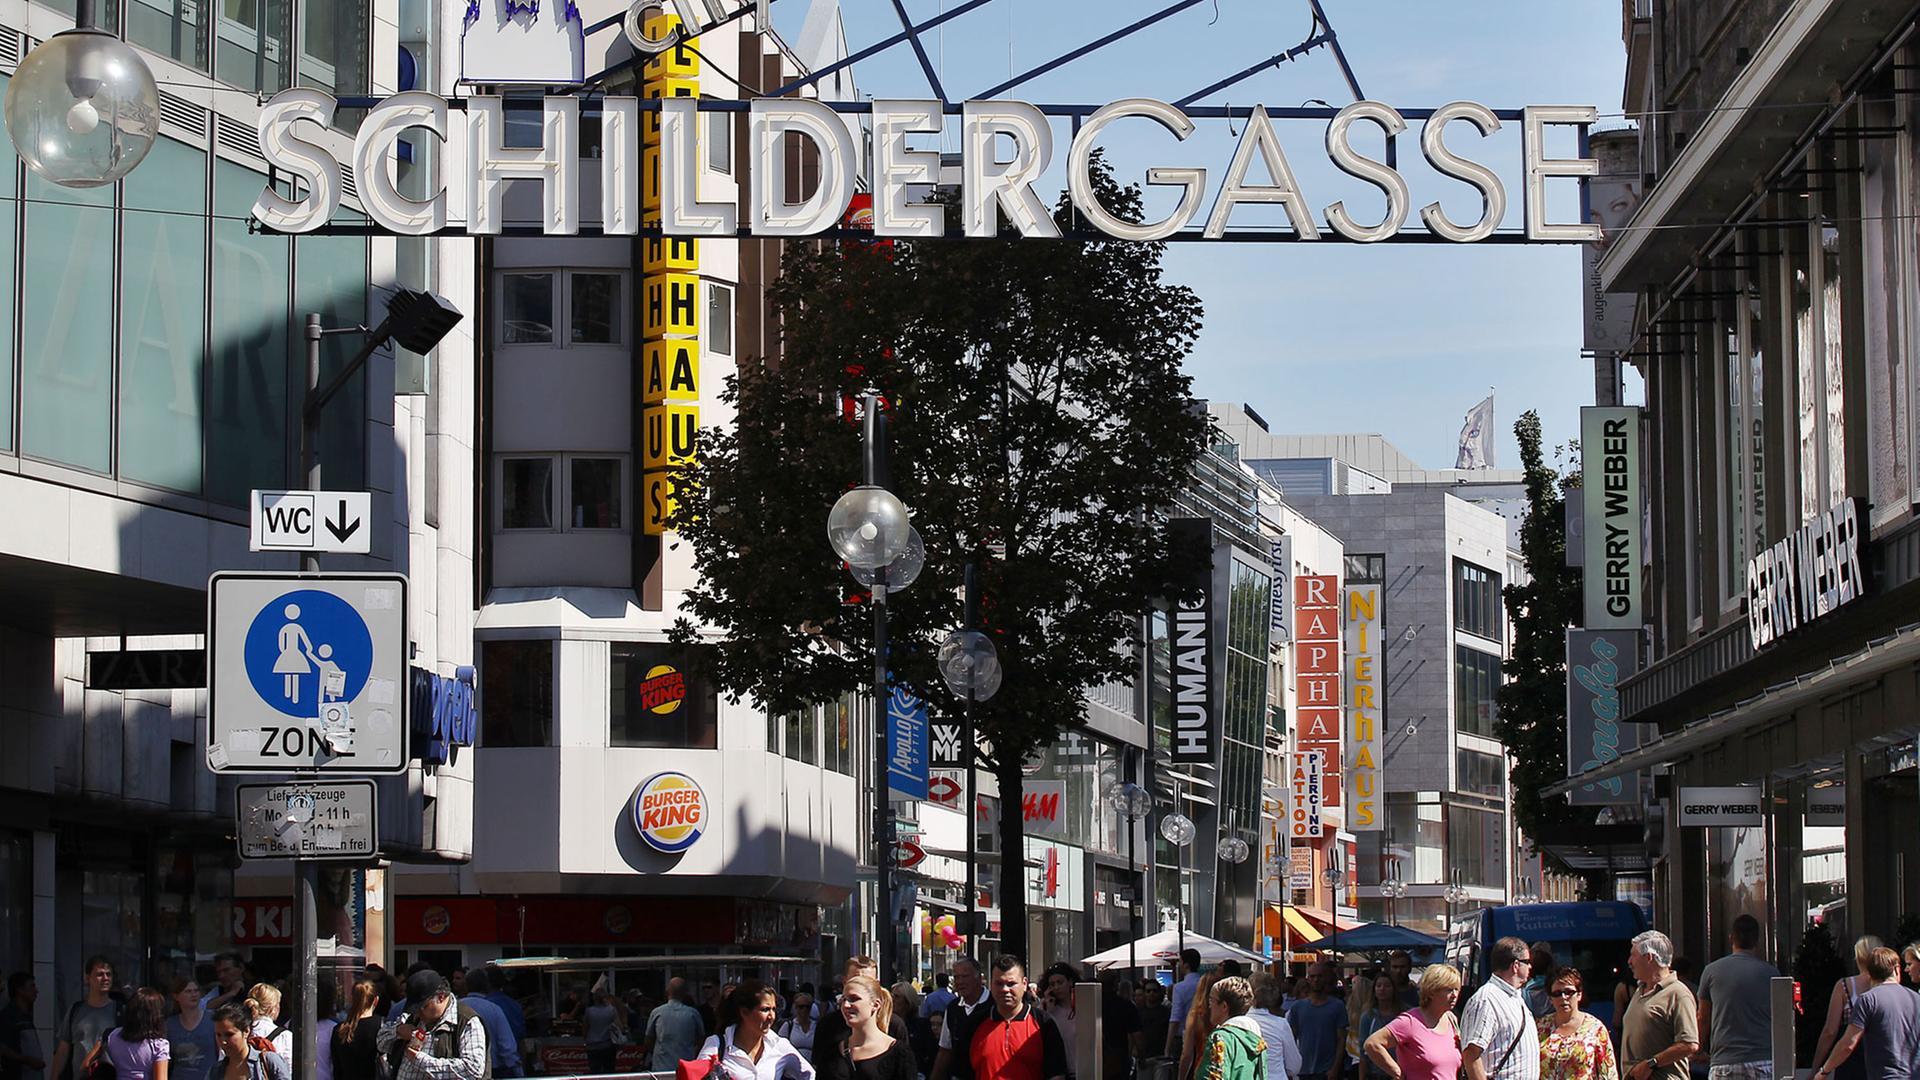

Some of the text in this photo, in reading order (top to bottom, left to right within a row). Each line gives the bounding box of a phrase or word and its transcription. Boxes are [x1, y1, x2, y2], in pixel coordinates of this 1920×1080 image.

[251, 88, 1601, 243] SCHILDERGASSE
[265, 507, 311, 535] WC
[1603, 418, 1631, 618] GERRY WEBER
[1747, 496, 1864, 650] GERRY WEBER
[640, 672, 683, 695] BURGER
[642, 683, 686, 710] KING
[1305, 579, 1329, 800] RAPHA
[643, 790, 700, 810] BURGER
[1293, 754, 1306, 836] TATTOO
[1309, 754, 1319, 836] PIERCING
[1684, 804, 1759, 815] GERRY WEBER
[642, 804, 701, 830] KING
[350, 838, 367, 850] frei
[255, 906, 292, 938] KI
